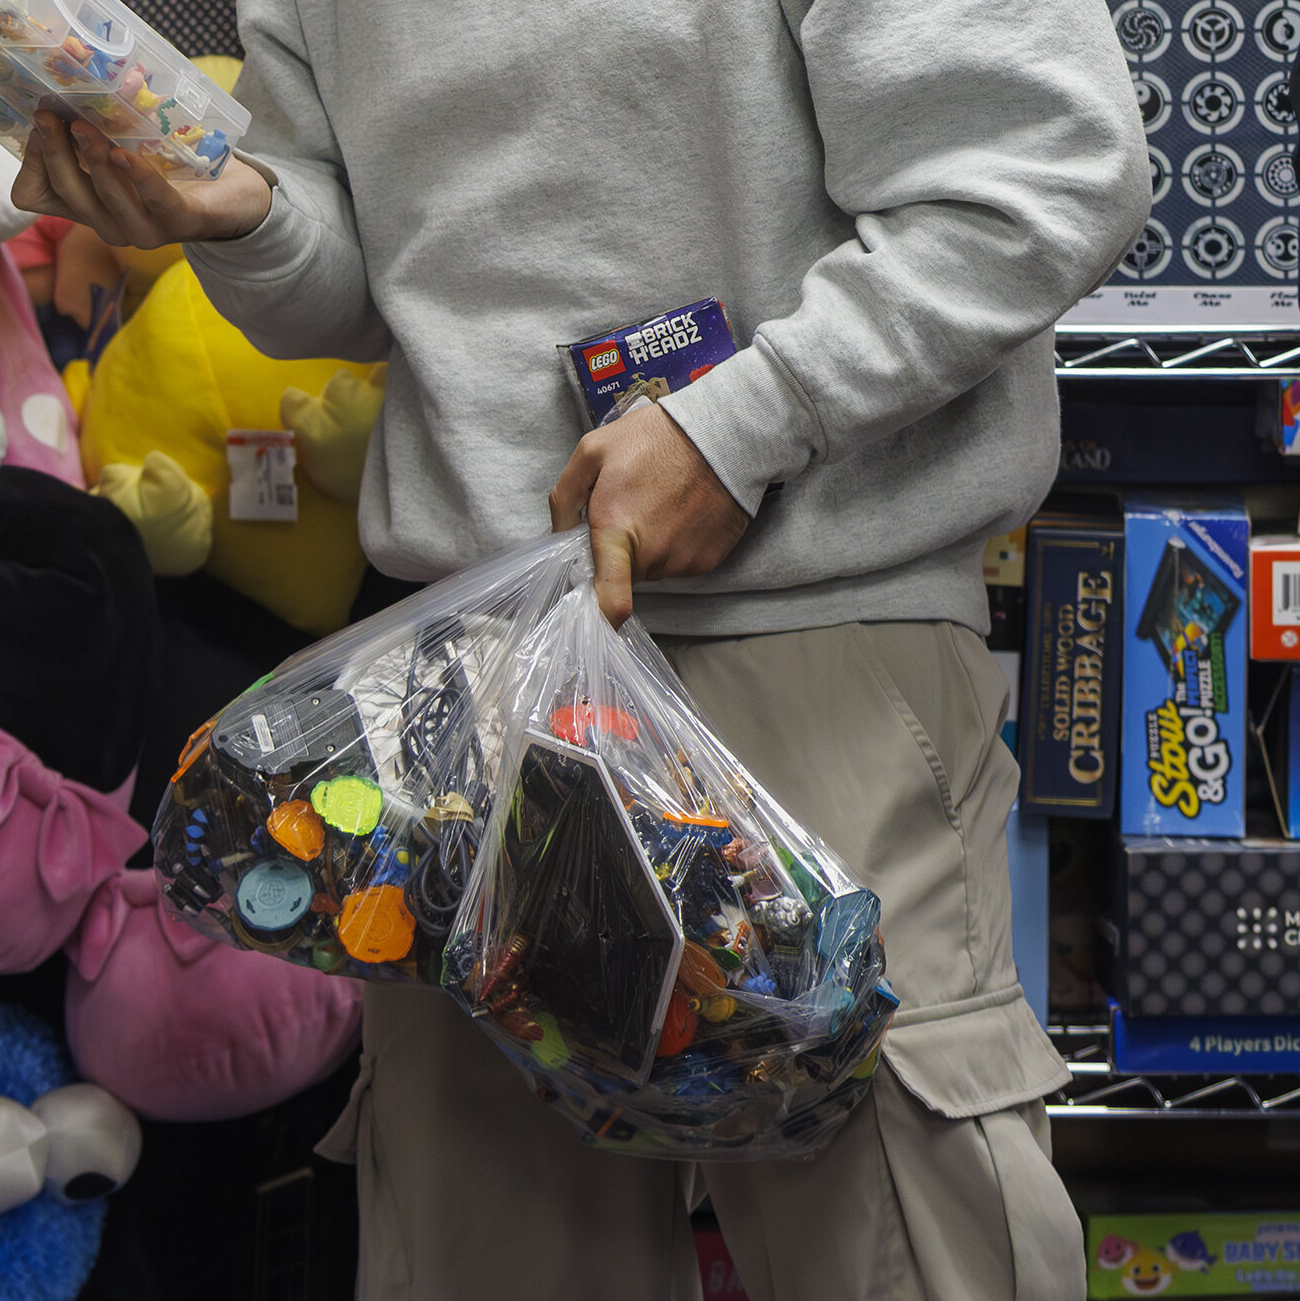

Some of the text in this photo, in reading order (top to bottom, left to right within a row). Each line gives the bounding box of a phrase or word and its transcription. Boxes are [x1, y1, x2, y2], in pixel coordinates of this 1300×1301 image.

[641, 311, 698, 344] BRICK
[590, 349, 619, 372] LEGO
[597, 381, 621, 395] 40671
[1053, 604, 1075, 742] SOLID WOOD
[1068, 570, 1114, 785] CRIBBAGE
[1149, 698, 1201, 819] Stow
[1189, 1037, 1201, 1053] 4
[1203, 1036, 1271, 1055] Players
